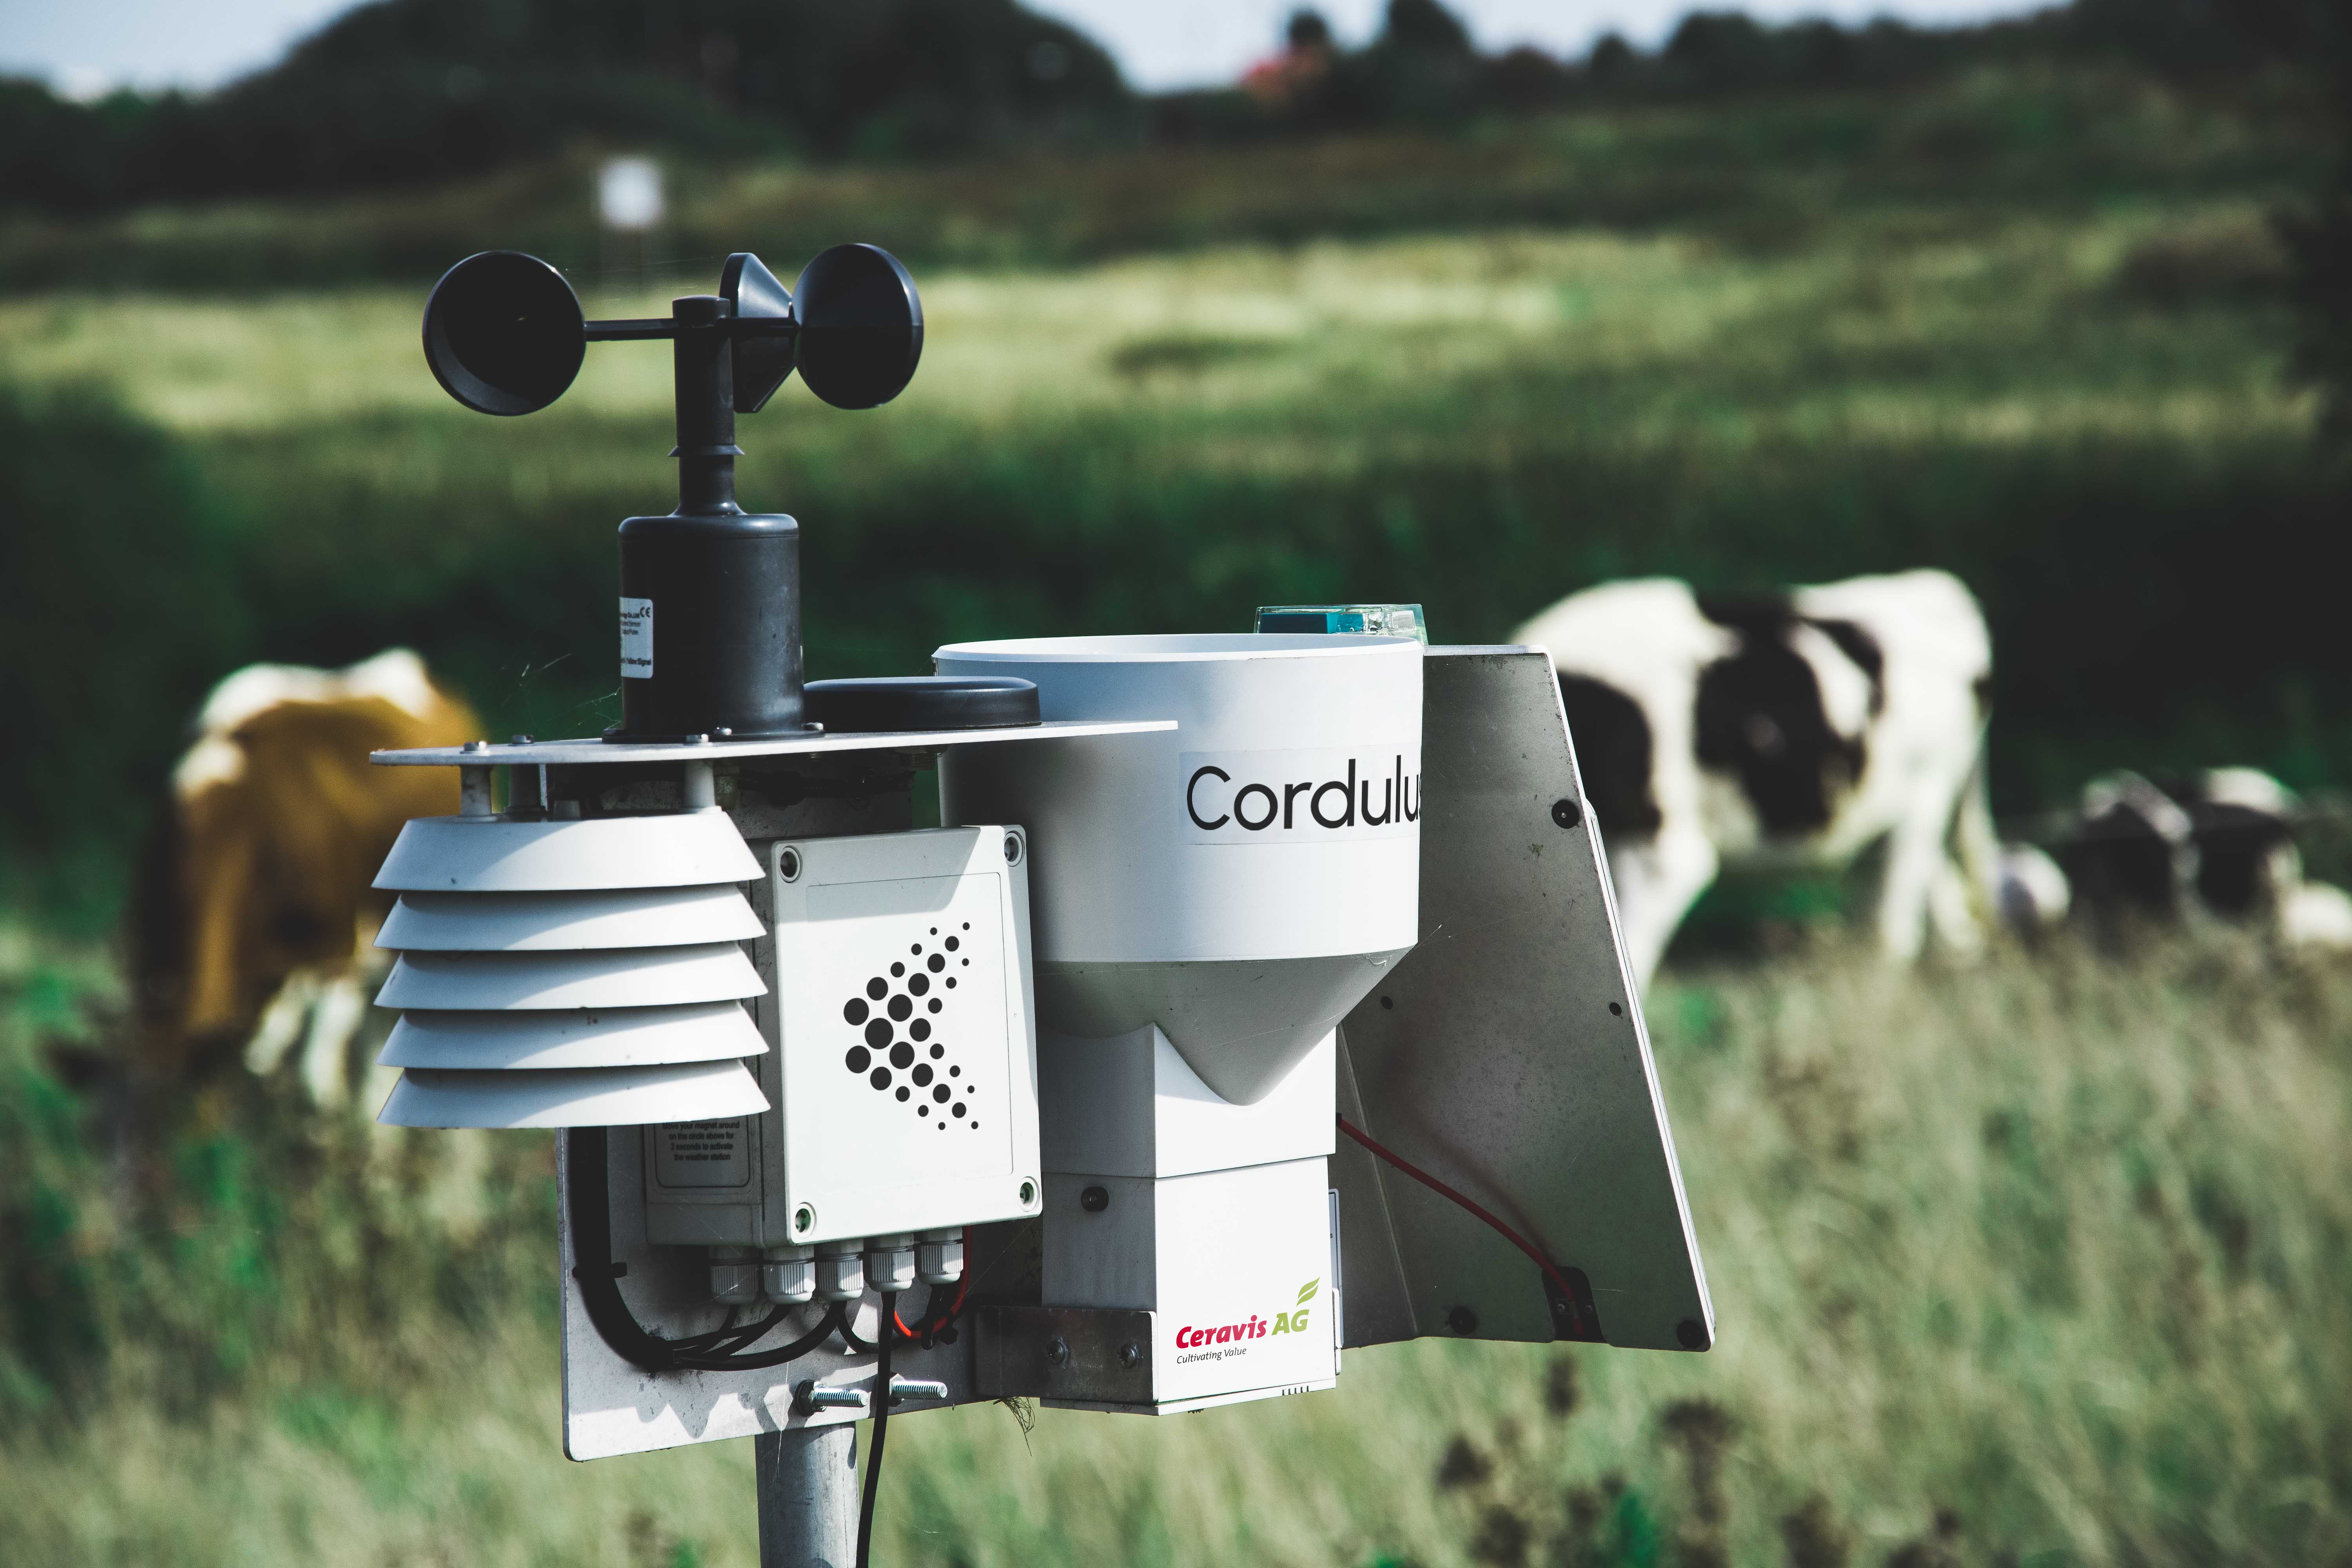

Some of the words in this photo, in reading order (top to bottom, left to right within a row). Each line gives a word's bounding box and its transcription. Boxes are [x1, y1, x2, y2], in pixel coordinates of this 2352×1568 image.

[695, 1122, 717, 1131] magnet
[1176, 1315, 1267, 1348] Ceravis
[1271, 1309, 1310, 1336] AG
[1177, 1350, 1222, 1364] Cultivating
[1223, 1348, 1247, 1357] Value
